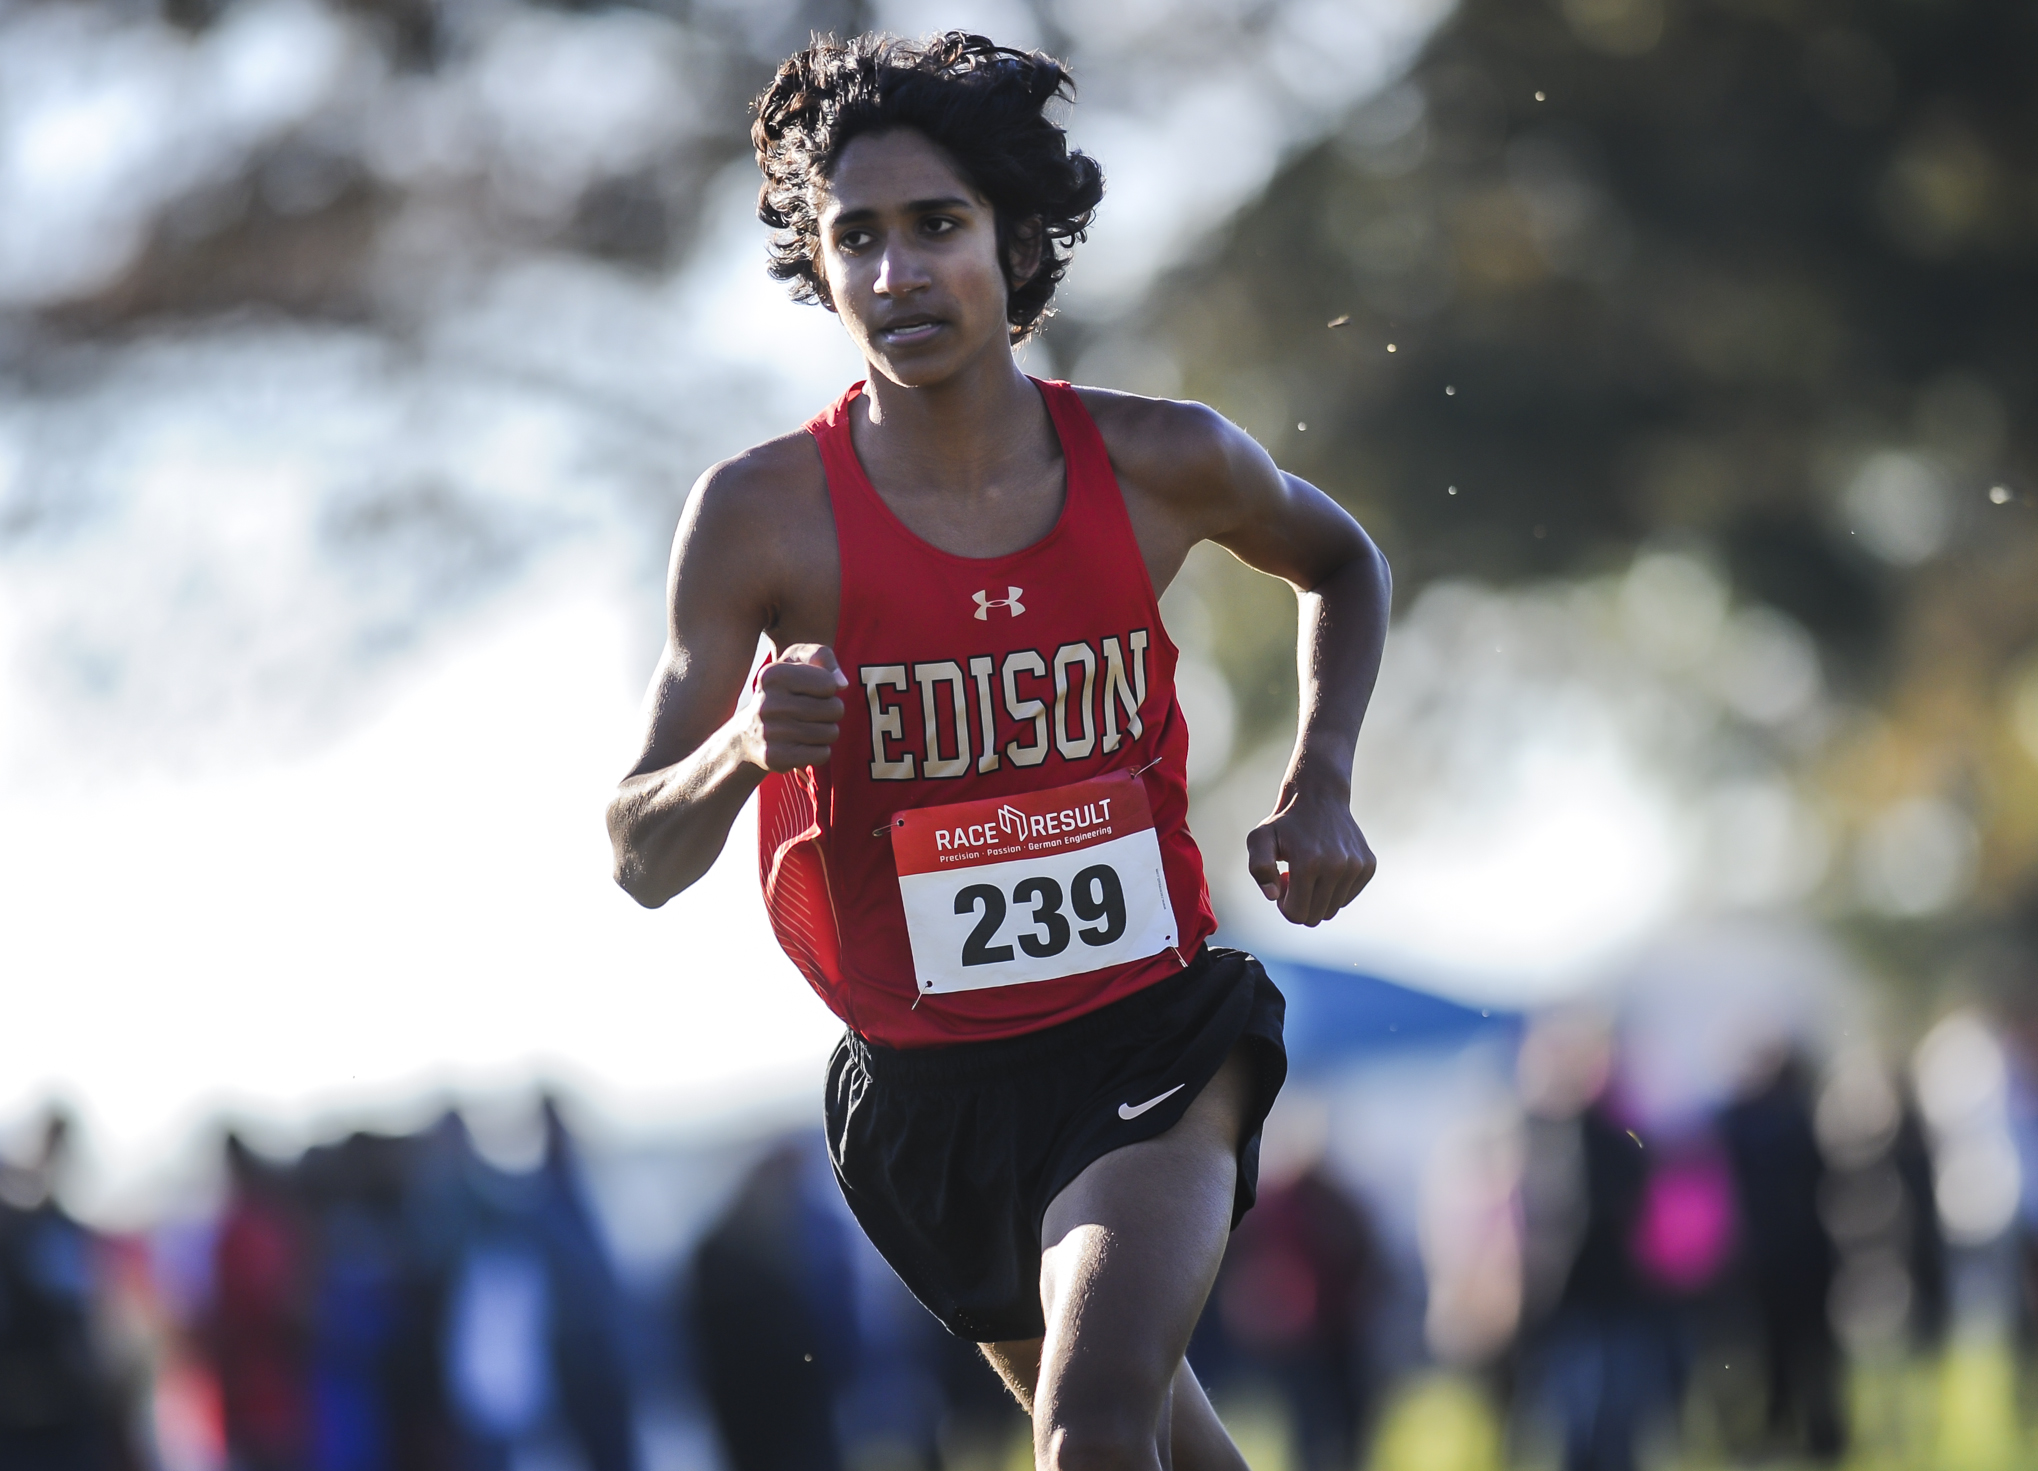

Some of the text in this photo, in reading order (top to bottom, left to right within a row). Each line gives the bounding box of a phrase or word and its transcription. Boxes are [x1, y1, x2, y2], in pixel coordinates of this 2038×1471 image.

[858, 628, 1149, 781] EDISON
[935, 798, 1111, 851] RACE RESULT
[939, 826, 1112, 863] Precision Passion German Engineering
[953, 863, 1127, 967] 239
